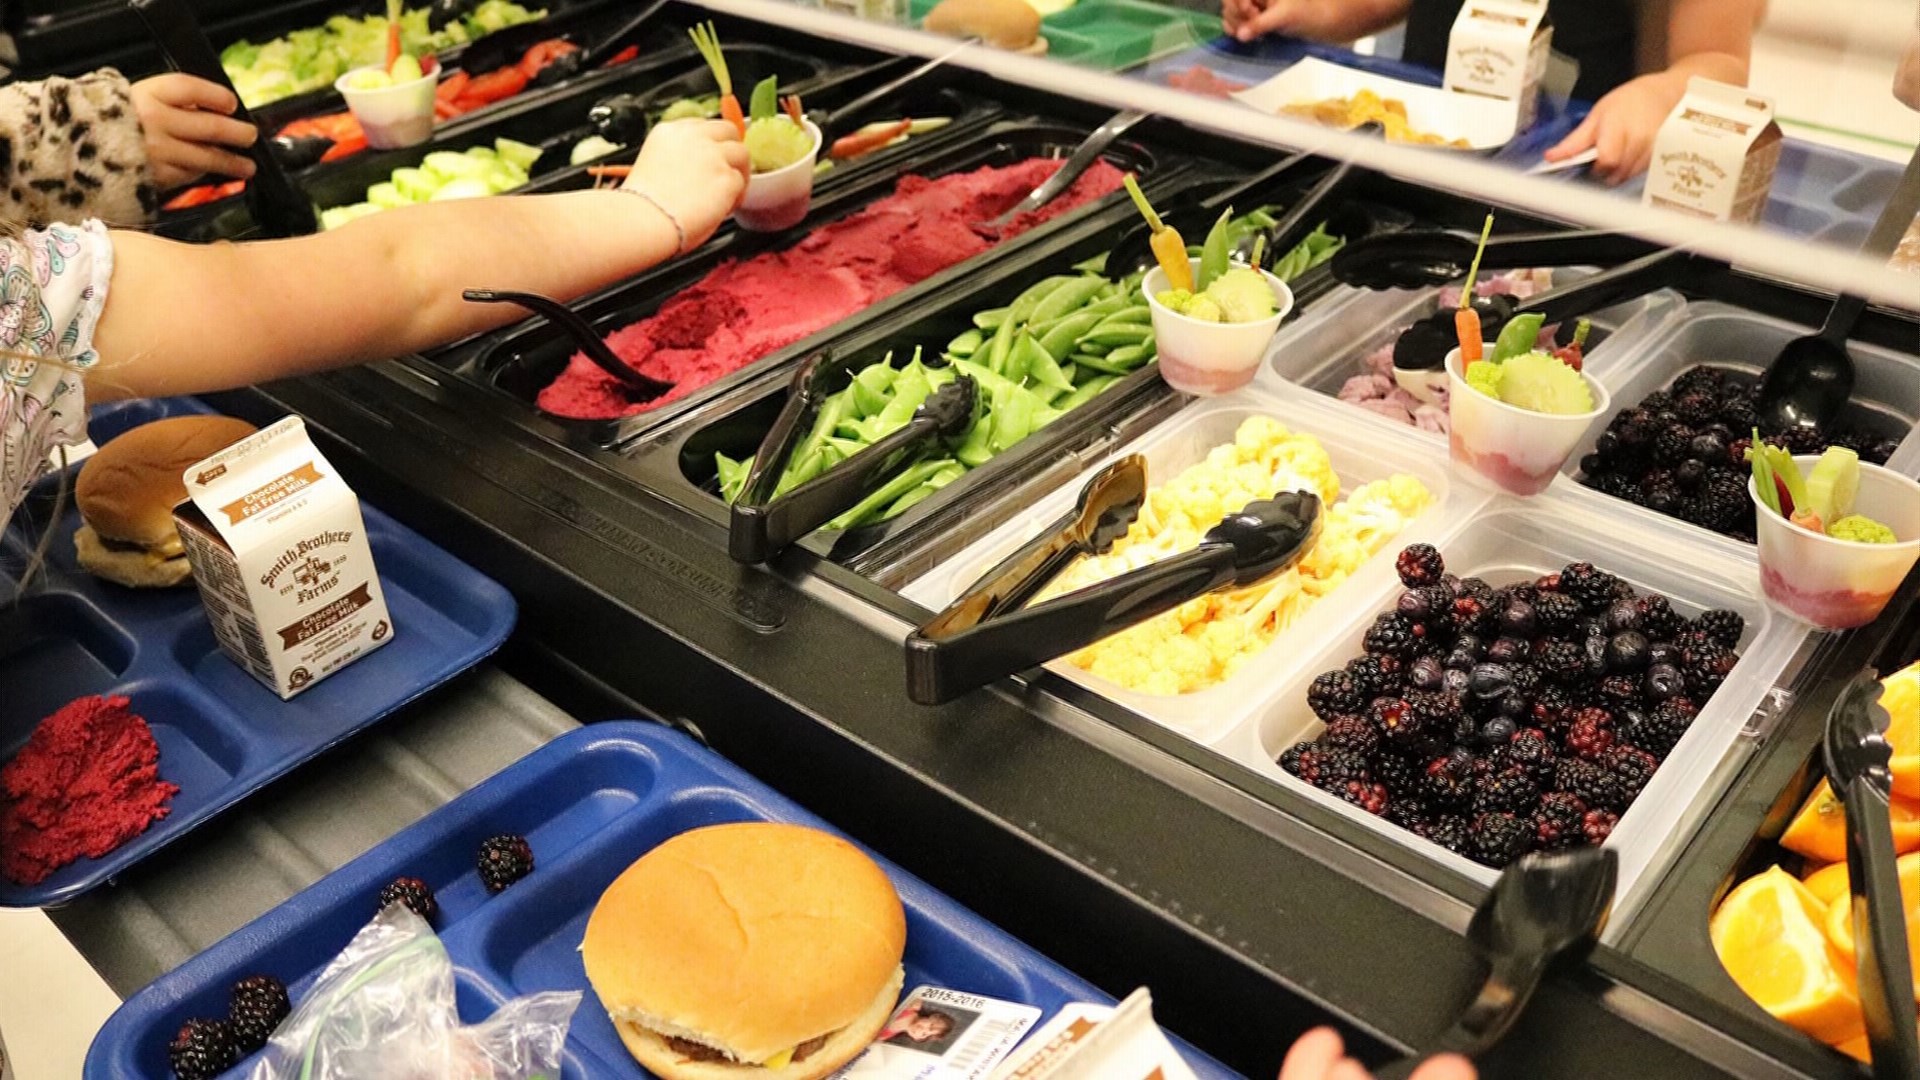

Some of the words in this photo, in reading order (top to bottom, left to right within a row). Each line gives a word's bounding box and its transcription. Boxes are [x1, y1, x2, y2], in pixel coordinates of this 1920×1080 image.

[242, 503, 260, 518] Fat
[262, 491, 285, 508] Free
[286, 478, 310, 496] Milk
[244, 474, 295, 505] Chocolate
[260, 548, 299, 589] Smith
[296, 530, 353, 557] Brothers
[297, 574, 340, 605] Farms
[298, 626, 315, 641] Fat
[316, 615, 338, 632] Free
[339, 601, 360, 620] Milk
[302, 597, 350, 628] Chocolate
[921, 988, 987, 1009] 2015-2016
